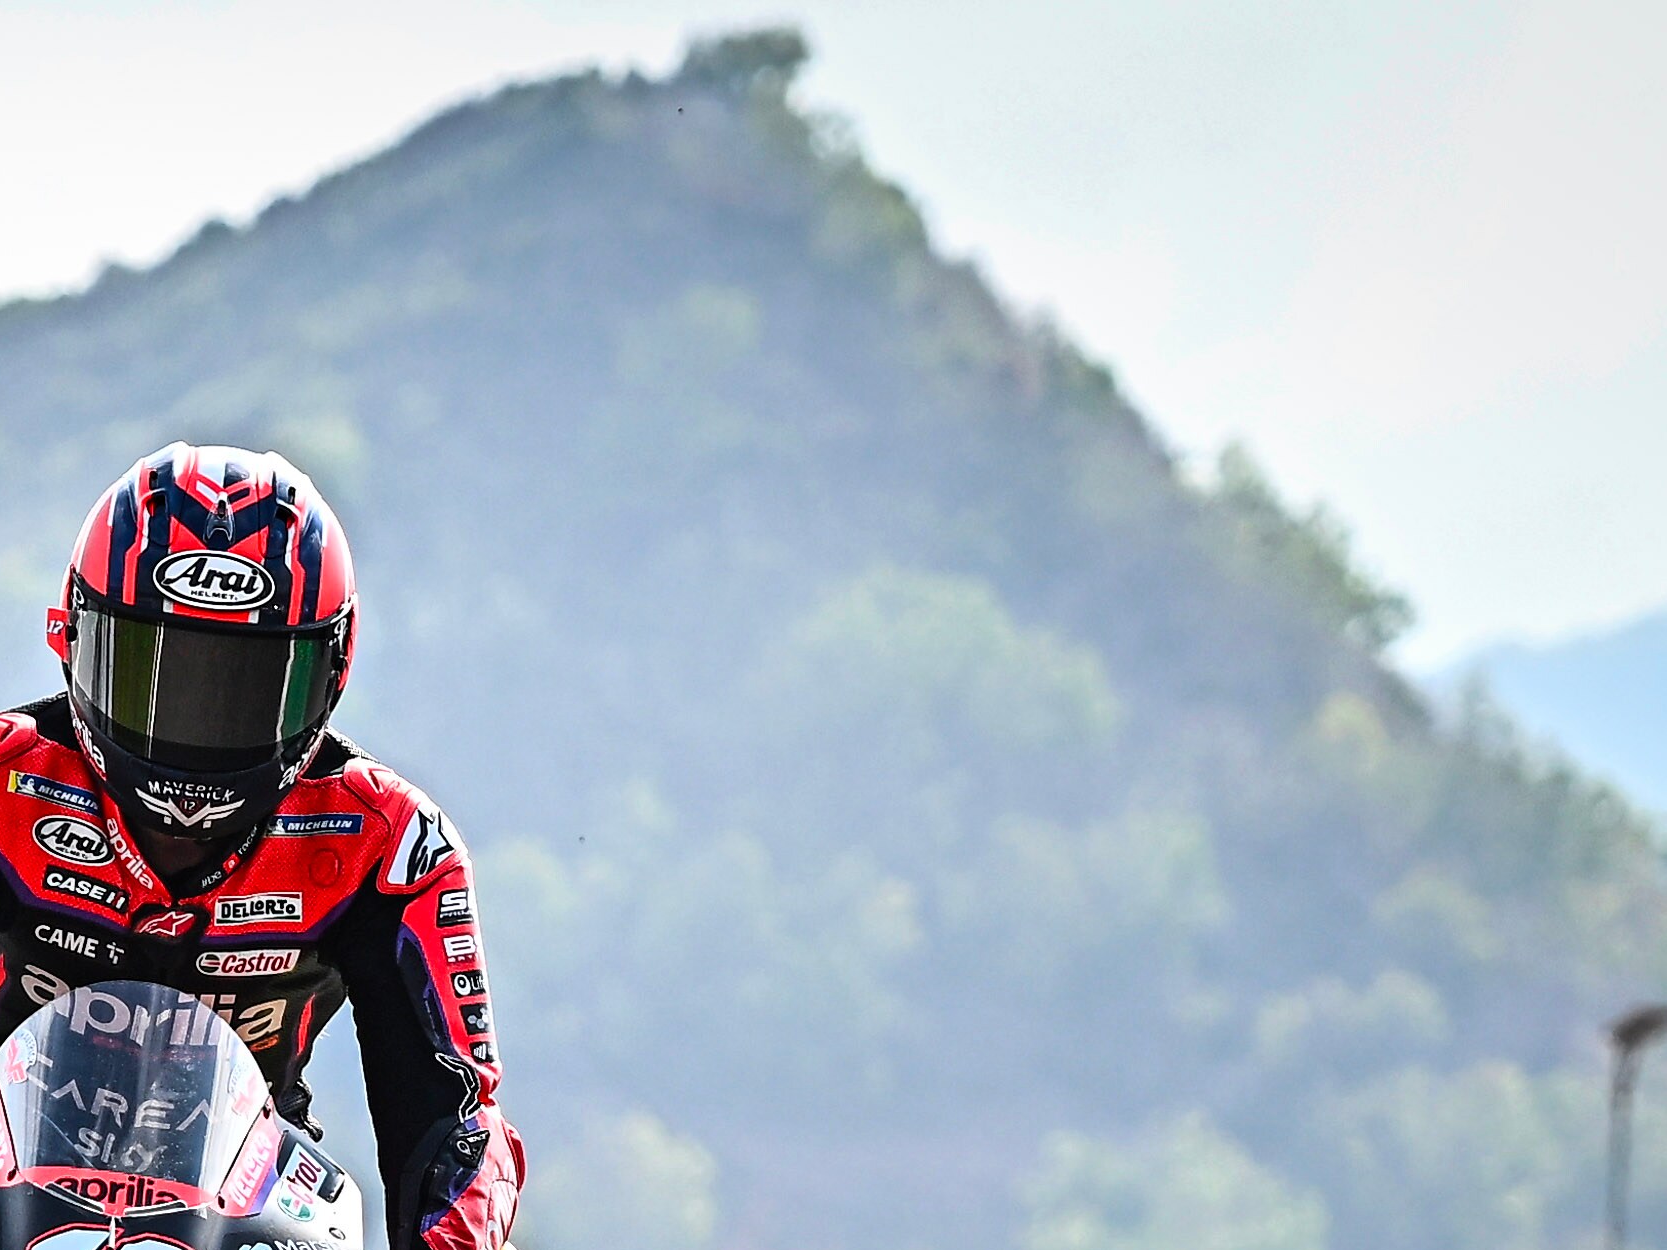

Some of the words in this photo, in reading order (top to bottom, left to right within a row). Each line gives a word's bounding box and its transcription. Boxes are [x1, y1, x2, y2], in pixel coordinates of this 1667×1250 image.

[162, 557, 260, 594] Arai
[47, 619, 65, 635] 12
[38, 784, 99, 810] MICHELIN
[148, 780, 236, 803] MAVERICK
[184, 800, 196, 811] 12
[287, 819, 353, 831] MICHELIN
[106, 818, 154, 890] aprilia
[46, 872, 108, 901] CASE
[221, 900, 296, 919] DELLORTO
[34, 924, 100, 959] CAME
[221, 952, 293, 973] Castrol
[21, 964, 288, 1047] aprilia
[53, 1175, 180, 1209] aprilia
